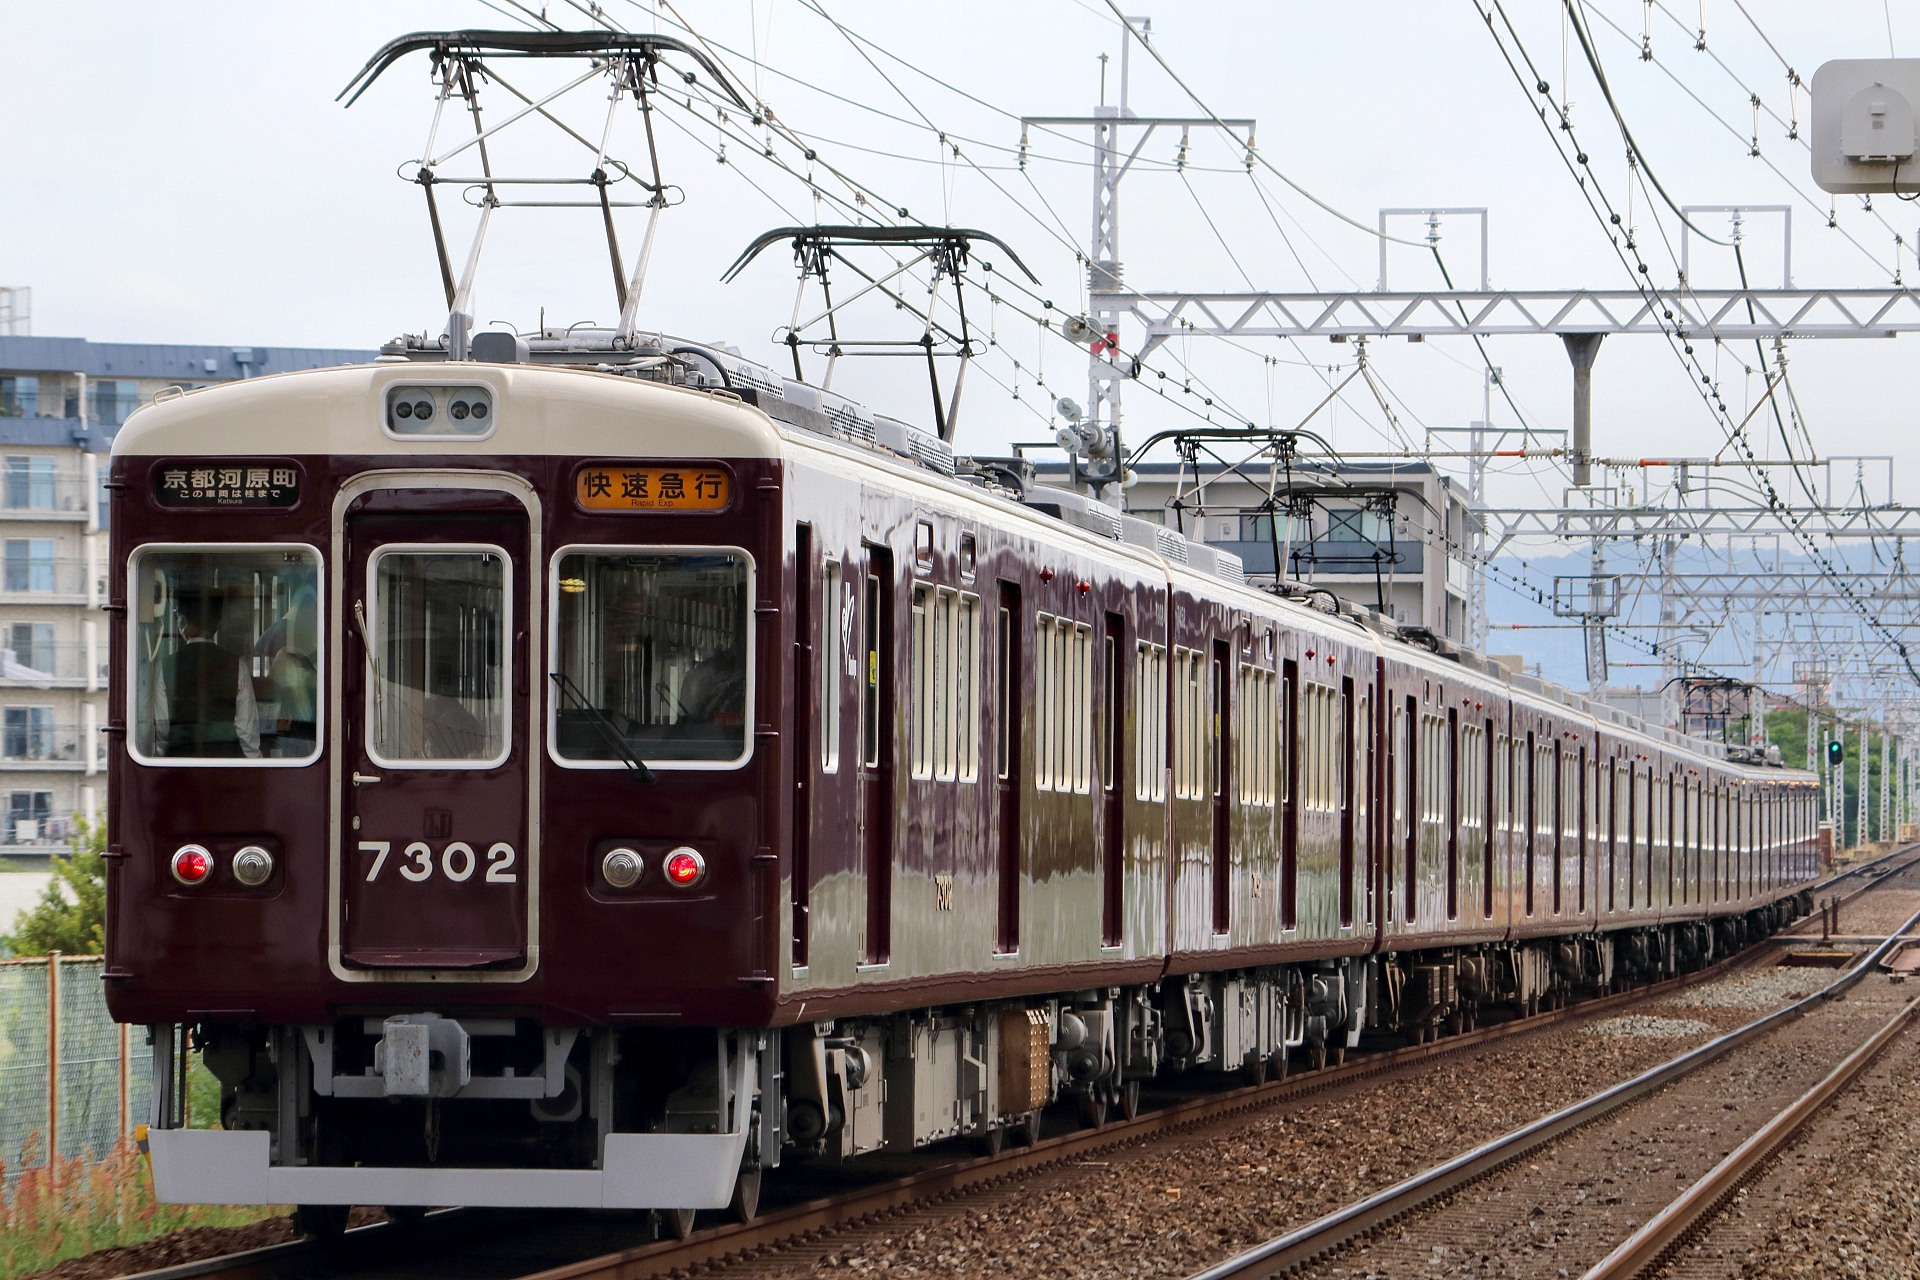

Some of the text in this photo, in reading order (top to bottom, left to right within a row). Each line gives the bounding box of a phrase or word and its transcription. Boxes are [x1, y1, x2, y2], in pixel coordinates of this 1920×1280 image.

[163, 468, 298, 489] 京都河原町
[584, 471, 723, 500] 快速急行
[179, 489, 281, 498] この車両は桂まで
[631, 499, 676, 508] Rapid Exp.
[358, 841, 517, 883] 7302
[934, 875, 953, 911] 7302
